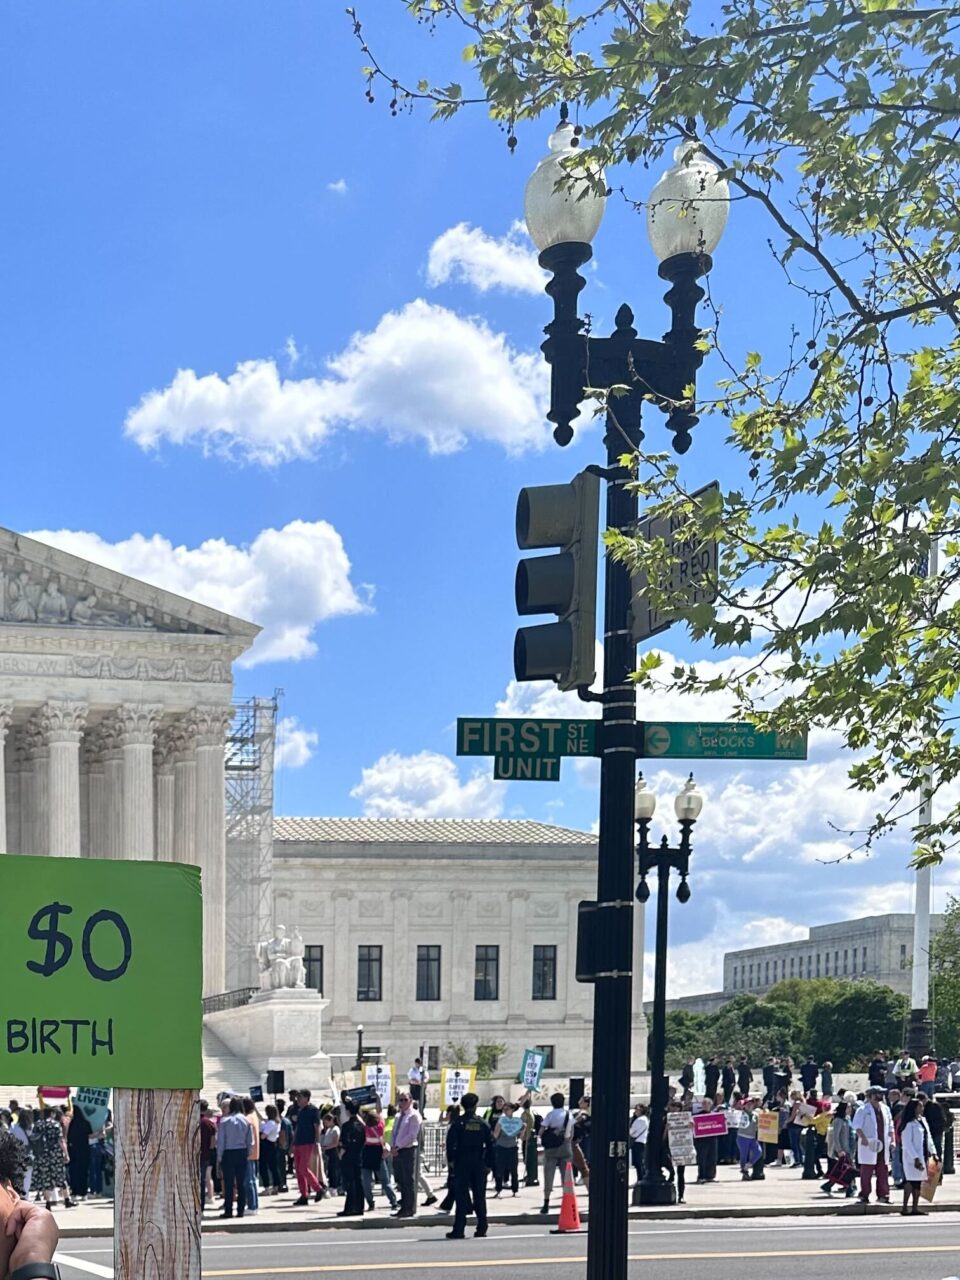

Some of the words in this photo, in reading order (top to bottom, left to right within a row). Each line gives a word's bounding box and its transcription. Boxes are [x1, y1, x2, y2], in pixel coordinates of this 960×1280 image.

[27, 658, 58, 673] LAW
[462, 721, 562, 753] FIRST
[567, 723, 587, 738] ST
[566, 739, 589, 753] NE
[701, 736, 755, 748] BLOCKS
[497, 756, 557, 779] UNIT
[25, 900, 133, 983] $0
[5, 1017, 115, 1058] BIRTH
[77, 1094, 107, 1107] LIVES
